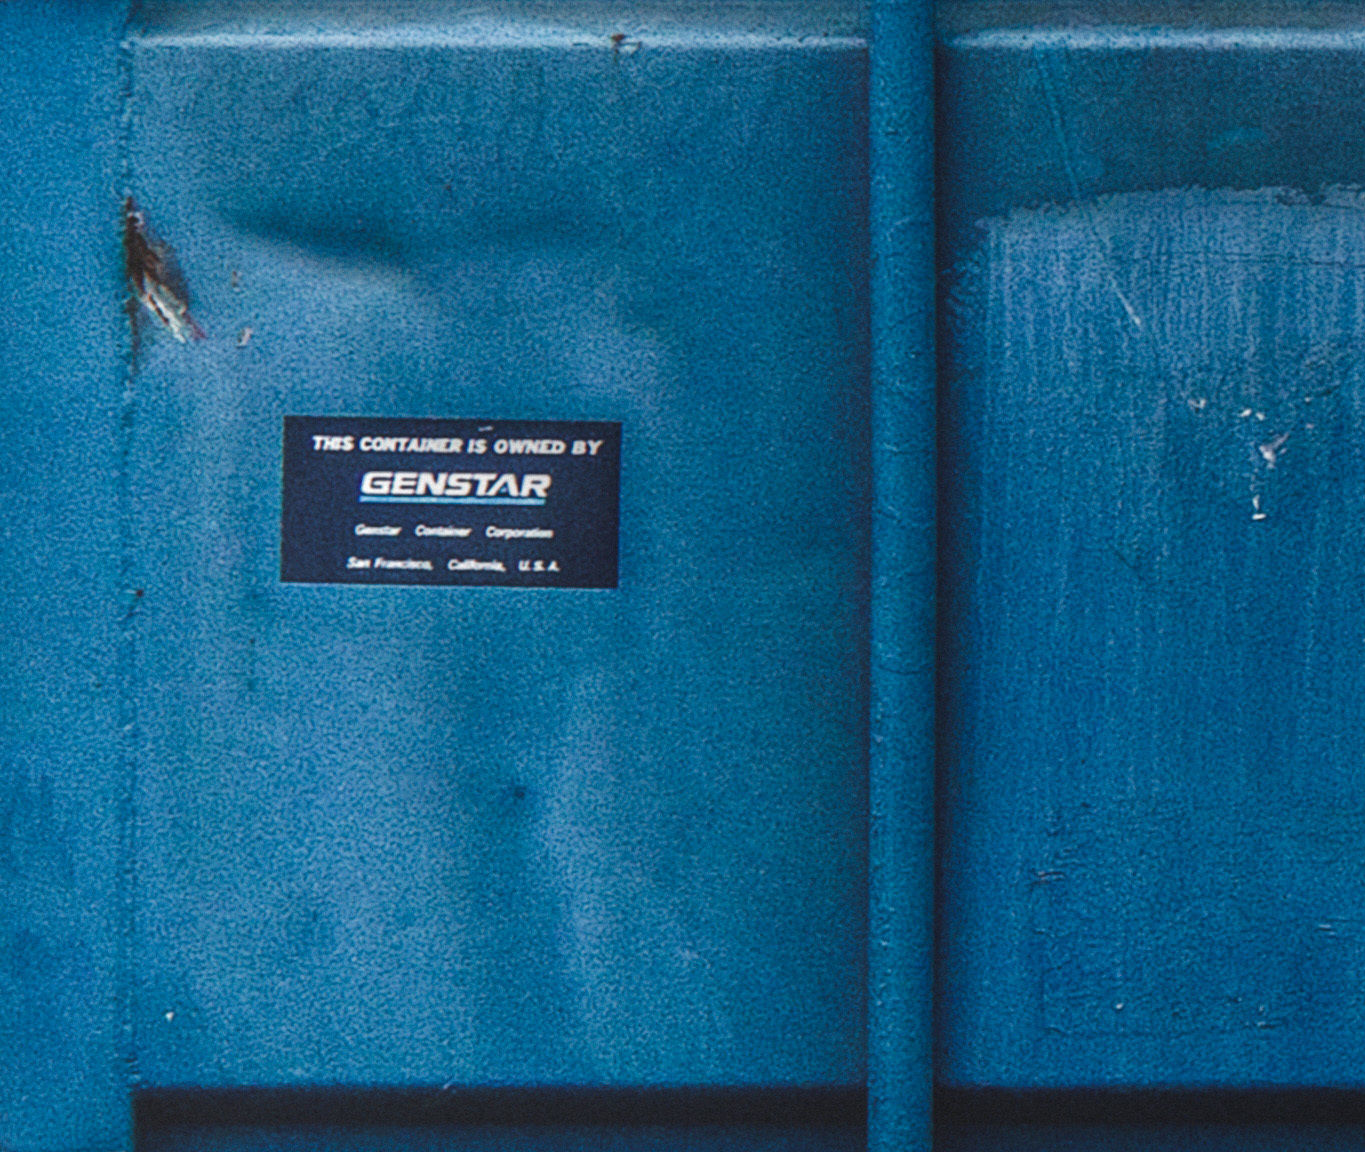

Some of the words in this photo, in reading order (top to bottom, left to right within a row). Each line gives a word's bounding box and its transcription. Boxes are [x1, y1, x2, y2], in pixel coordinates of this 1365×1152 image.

[312, 435, 355, 450] THIS
[359, 437, 463, 453] CONTAINER
[466, 438, 487, 454] IS
[493, 439, 566, 454] OWNED
[571, 440, 602, 455] BY
[360, 471, 551, 497] GENSTAR
[414, 525, 472, 537] Container
[486, 526, 554, 539] Corporation
[347, 556, 371, 568] San
